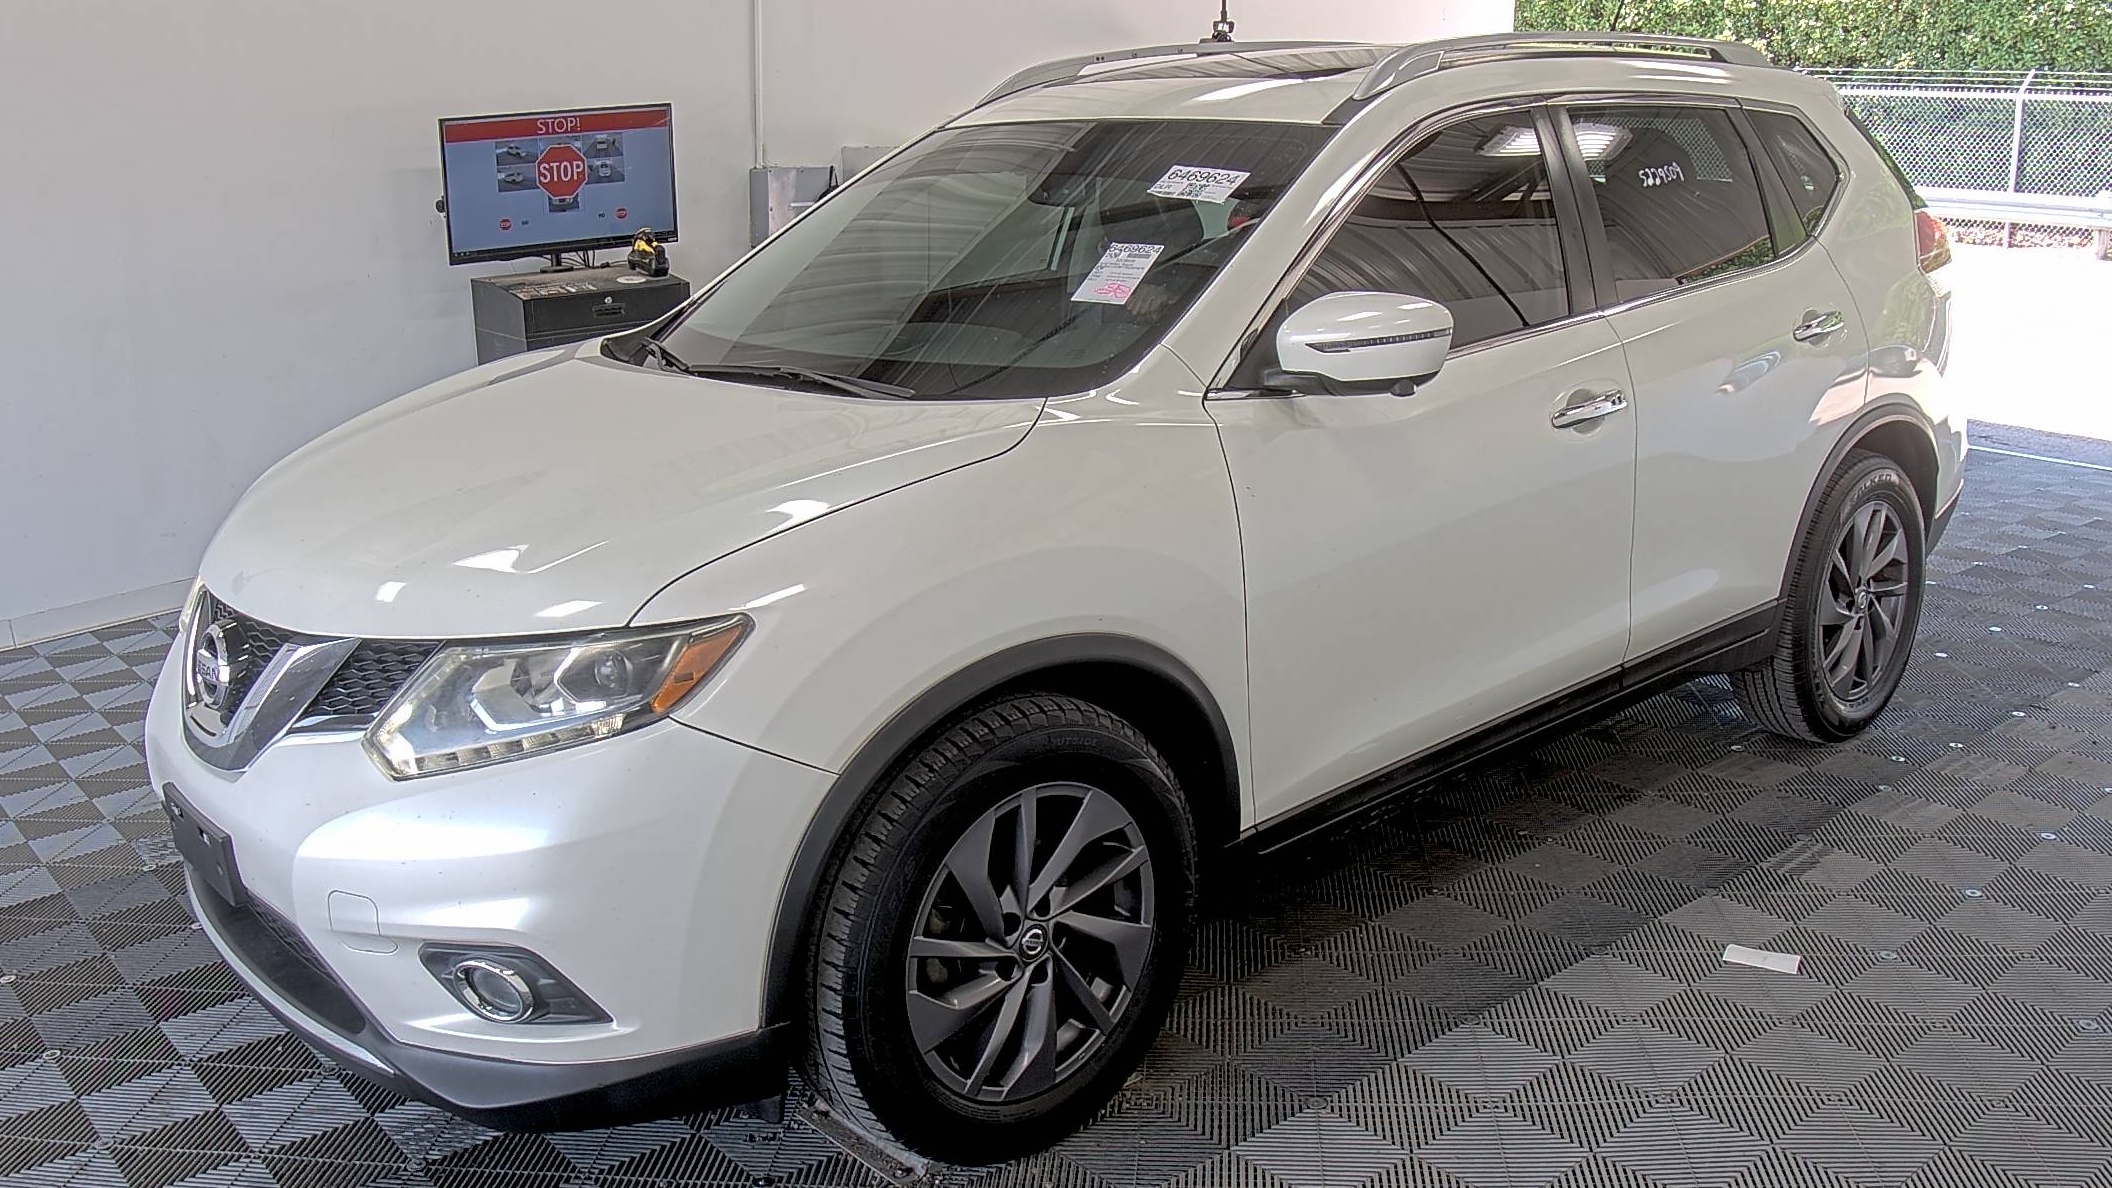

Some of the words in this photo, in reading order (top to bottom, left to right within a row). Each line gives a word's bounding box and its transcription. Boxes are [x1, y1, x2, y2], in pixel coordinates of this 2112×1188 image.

[536, 117, 581, 134] STOP!
[539, 160, 584, 183] STOP
[1167, 168, 1240, 186] 6469624
[1638, 161, 1685, 187] 5229509
[1108, 244, 1162, 255] 6469624
